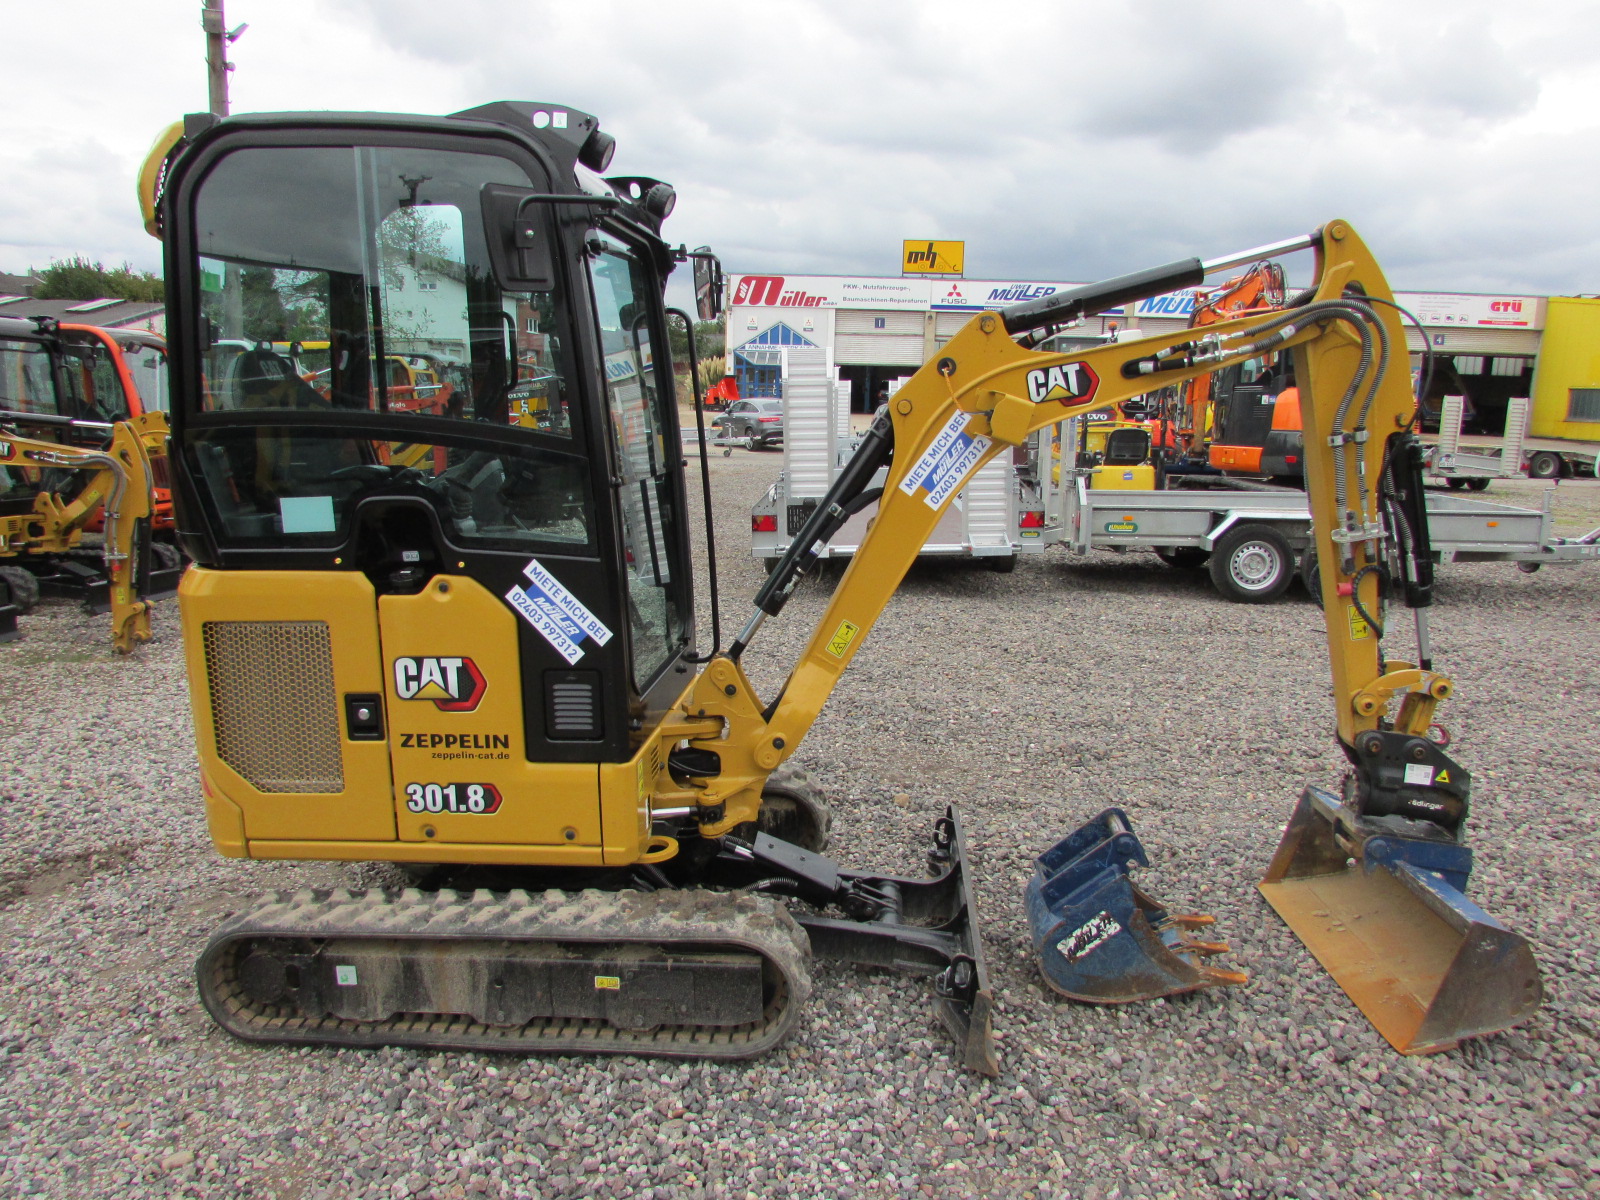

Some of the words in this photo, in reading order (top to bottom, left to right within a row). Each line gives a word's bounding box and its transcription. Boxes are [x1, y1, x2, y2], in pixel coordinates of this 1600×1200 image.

[843, 296, 928, 304] Baumaschinen-Reparaturen
[1490, 299, 1523, 313] GTÜ
[1027, 362, 1080, 403] CAT
[905, 459, 932, 490] MIETE
[928, 432, 953, 460] MICH
[930, 473, 958, 505] 02403
[954, 439, 987, 475] 997312
[931, 438, 967, 486] MÜLLER
[529, 566, 563, 599] MIETE
[560, 595, 589, 624] MICH
[586, 621, 607, 640] BEI
[533, 596, 580, 636] MÜLLER
[512, 592, 543, 624] 02403
[542, 622, 578, 659] 997312
[394, 657, 463, 699] CAT
[400, 733, 510, 749] ZEPPELIN
[431, 751, 510, 760] zeppelin-cat.de
[406, 782, 486, 813] 301.8
